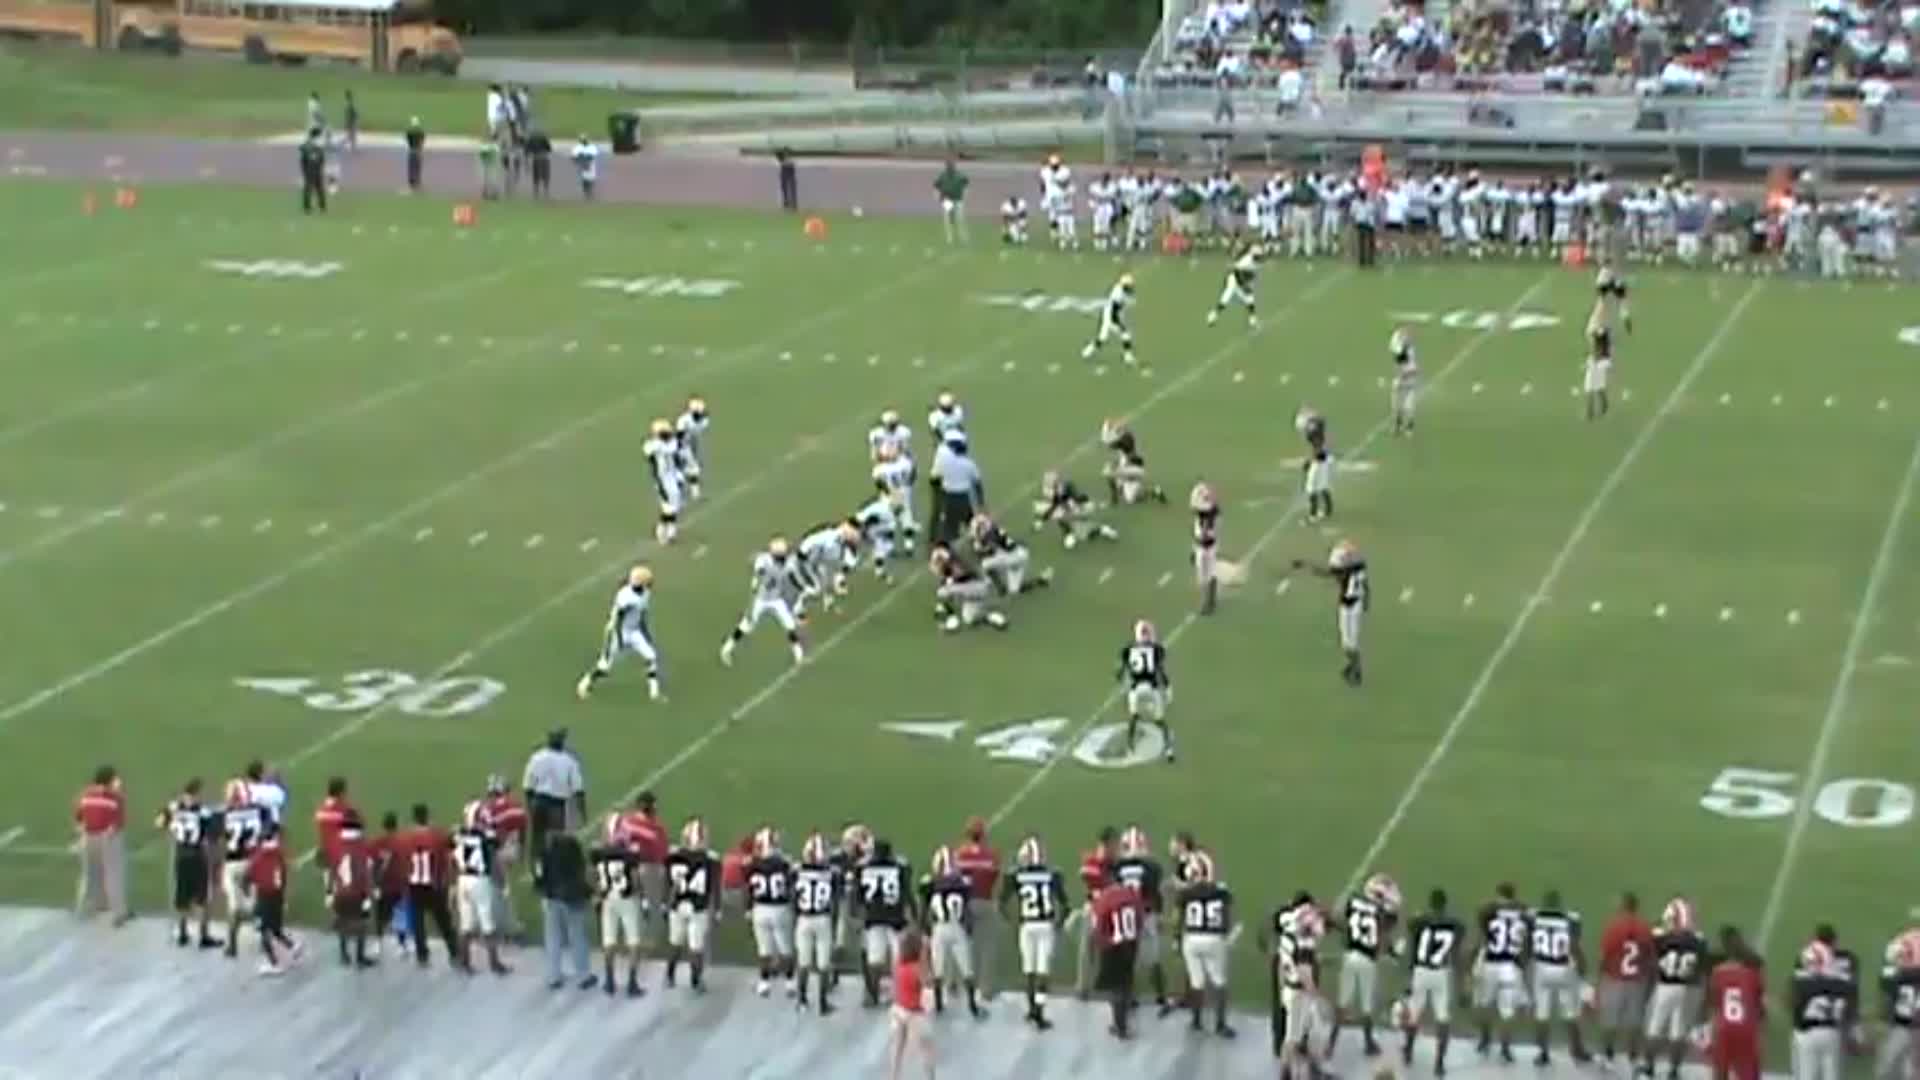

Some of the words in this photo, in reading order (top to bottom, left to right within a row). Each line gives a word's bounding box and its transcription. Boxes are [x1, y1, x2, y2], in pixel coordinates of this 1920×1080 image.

[1128, 647, 1155, 674] 51
[304, 668, 507, 717] 30
[975, 716, 1166, 768] 40
[1699, 767, 1915, 828] 50
[409, 851, 431, 884] 11
[671, 864, 706, 895] 54
[796, 880, 831, 912] 38
[1019, 884, 1052, 917] 21
[1112, 907, 1136, 943] 10
[1417, 927, 1454, 965] 17
[1621, 941, 1639, 975] 2
[1723, 987, 1744, 1022] 6
